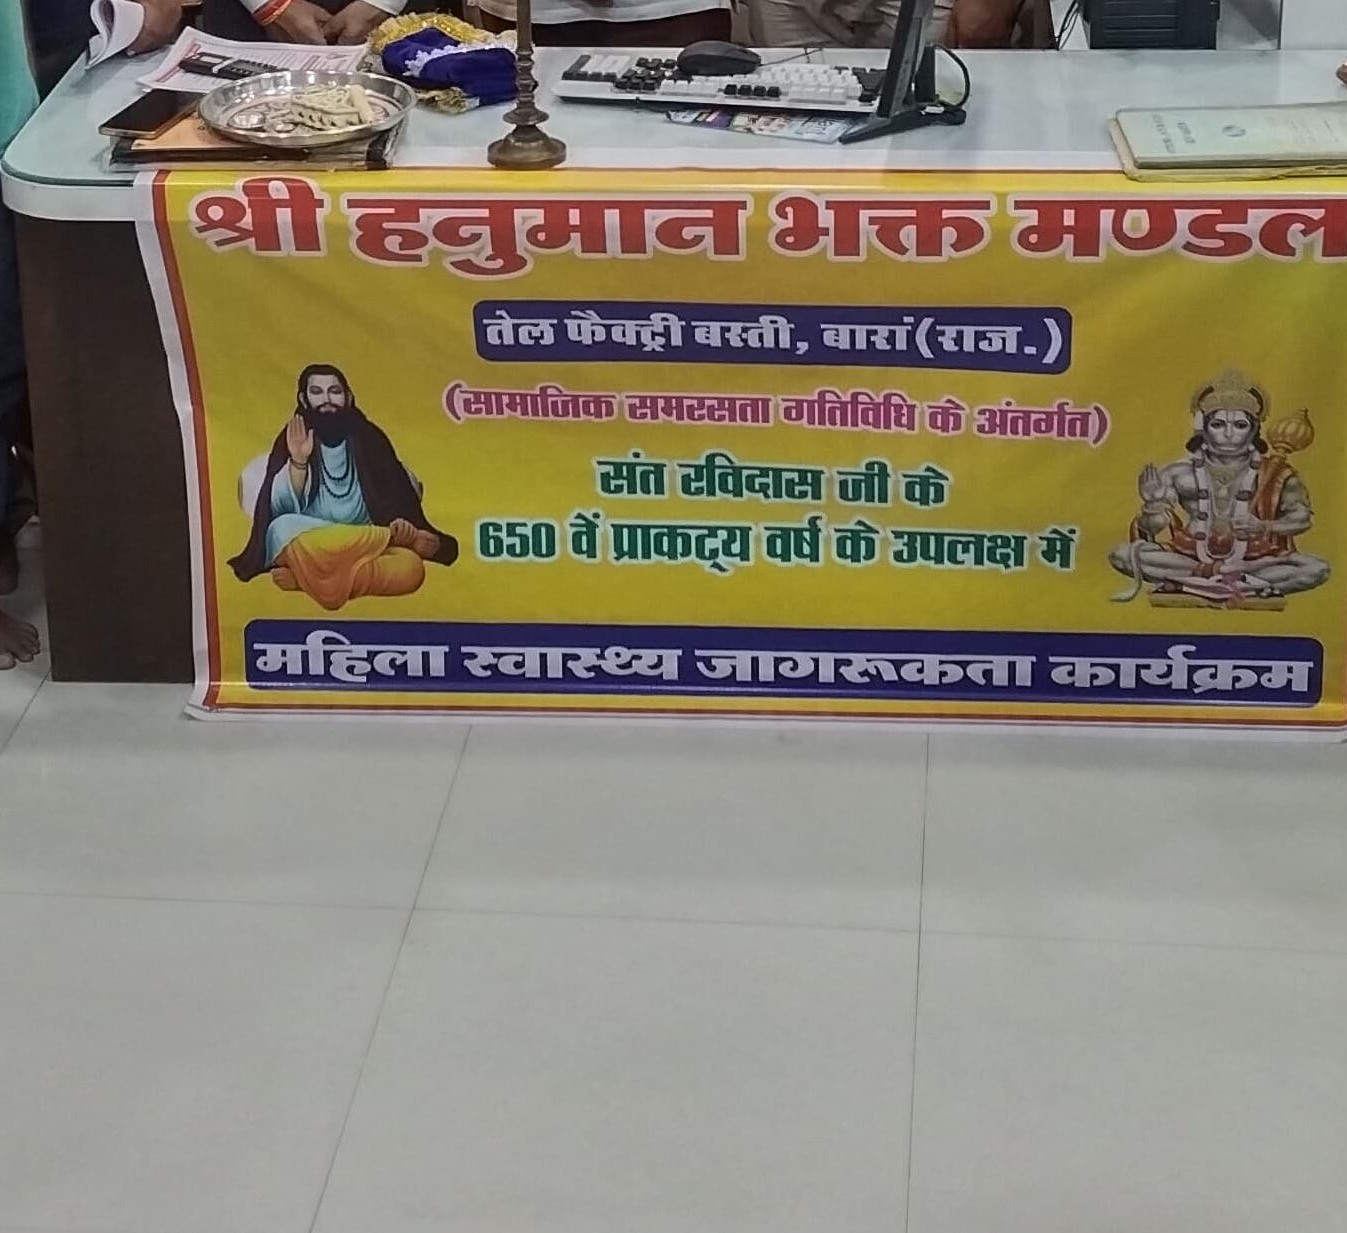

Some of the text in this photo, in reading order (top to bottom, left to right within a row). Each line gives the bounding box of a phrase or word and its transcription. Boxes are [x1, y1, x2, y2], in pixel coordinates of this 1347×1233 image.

[195, 177, 324, 252] श्री
[347, 198, 748, 276] हनुमान
[774, 196, 991, 258] भक्त
[483, 310, 557, 346] तेल
[564, 310, 686, 352] फैक्ट्री
[691, 315, 810, 355] बस्ती,
[445, 383, 1109, 445] (सामाजिक समरसता गतिविधि के अंतर्गत)
[596, 452, 950, 507] संत रविदास जी के
[479, 512, 1078, 573] 650 वें प्राकट्य वर्ष के उपलक्ष में
[252, 630, 1314, 695] महिला स्वास्थ्य जागरूकता कार्यक्रम
